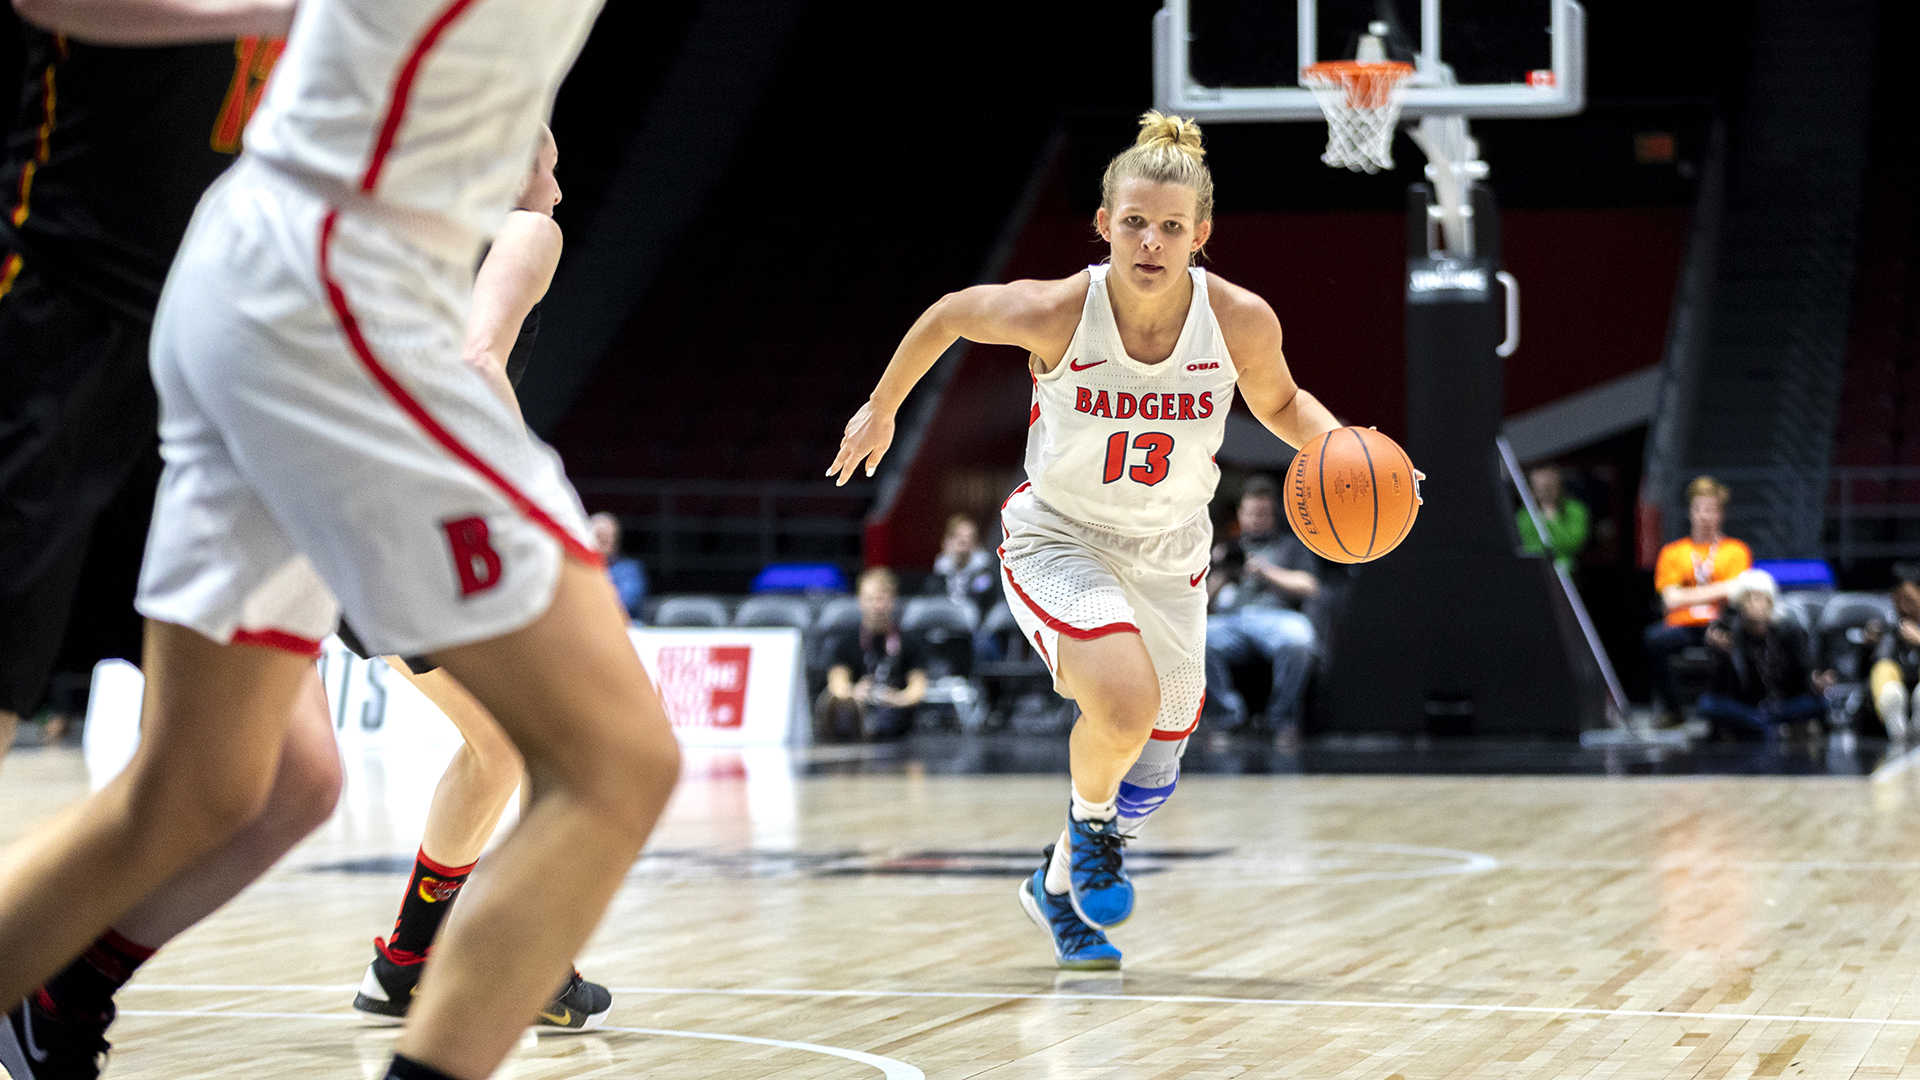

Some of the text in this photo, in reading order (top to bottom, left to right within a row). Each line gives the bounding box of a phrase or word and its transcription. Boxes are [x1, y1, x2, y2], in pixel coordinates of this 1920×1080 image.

[1074, 386, 1214, 420] BADGERS
[1102, 431, 1175, 487] 13
[440, 516, 502, 598] B
